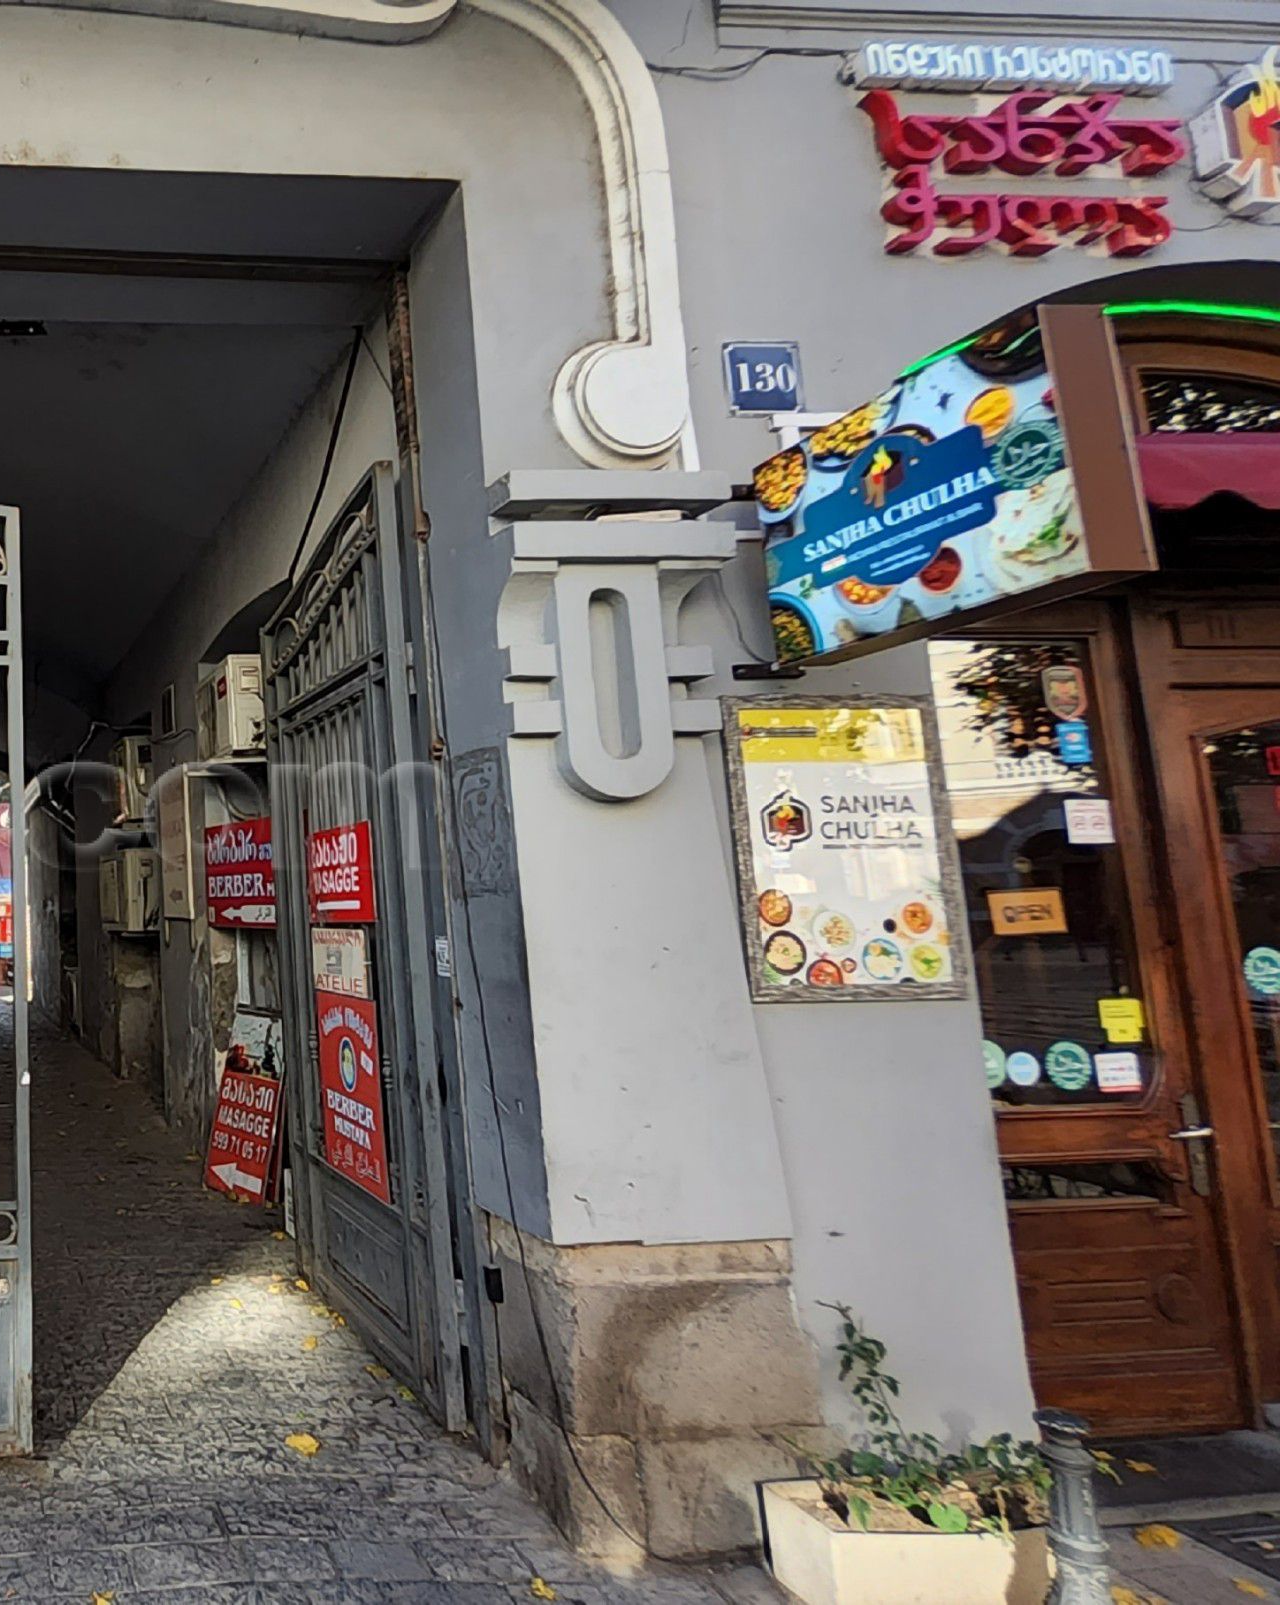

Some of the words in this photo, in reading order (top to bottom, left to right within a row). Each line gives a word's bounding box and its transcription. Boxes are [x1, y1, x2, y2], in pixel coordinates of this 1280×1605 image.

[866, 44, 986, 77] ინდური
[994, 45, 1172, 84] რესტორანი
[735, 362, 797, 394] 130
[803, 515, 885, 562] SANJHA
[882, 466, 998, 527] CHULHA
[821, 795, 917, 818] SANJHA
[820, 820, 924, 841] CHULHA
[208, 872, 266, 898] BERBER
[316, 973, 363, 994] ATELIE
[222, 1077, 275, 1113] მასაჟი
[326, 1088, 376, 1132] BERBER
[217, 1104, 271, 1138] MASAGGE
[230, 1135, 241, 1156] 71
[255, 1144, 268, 1164] 17
